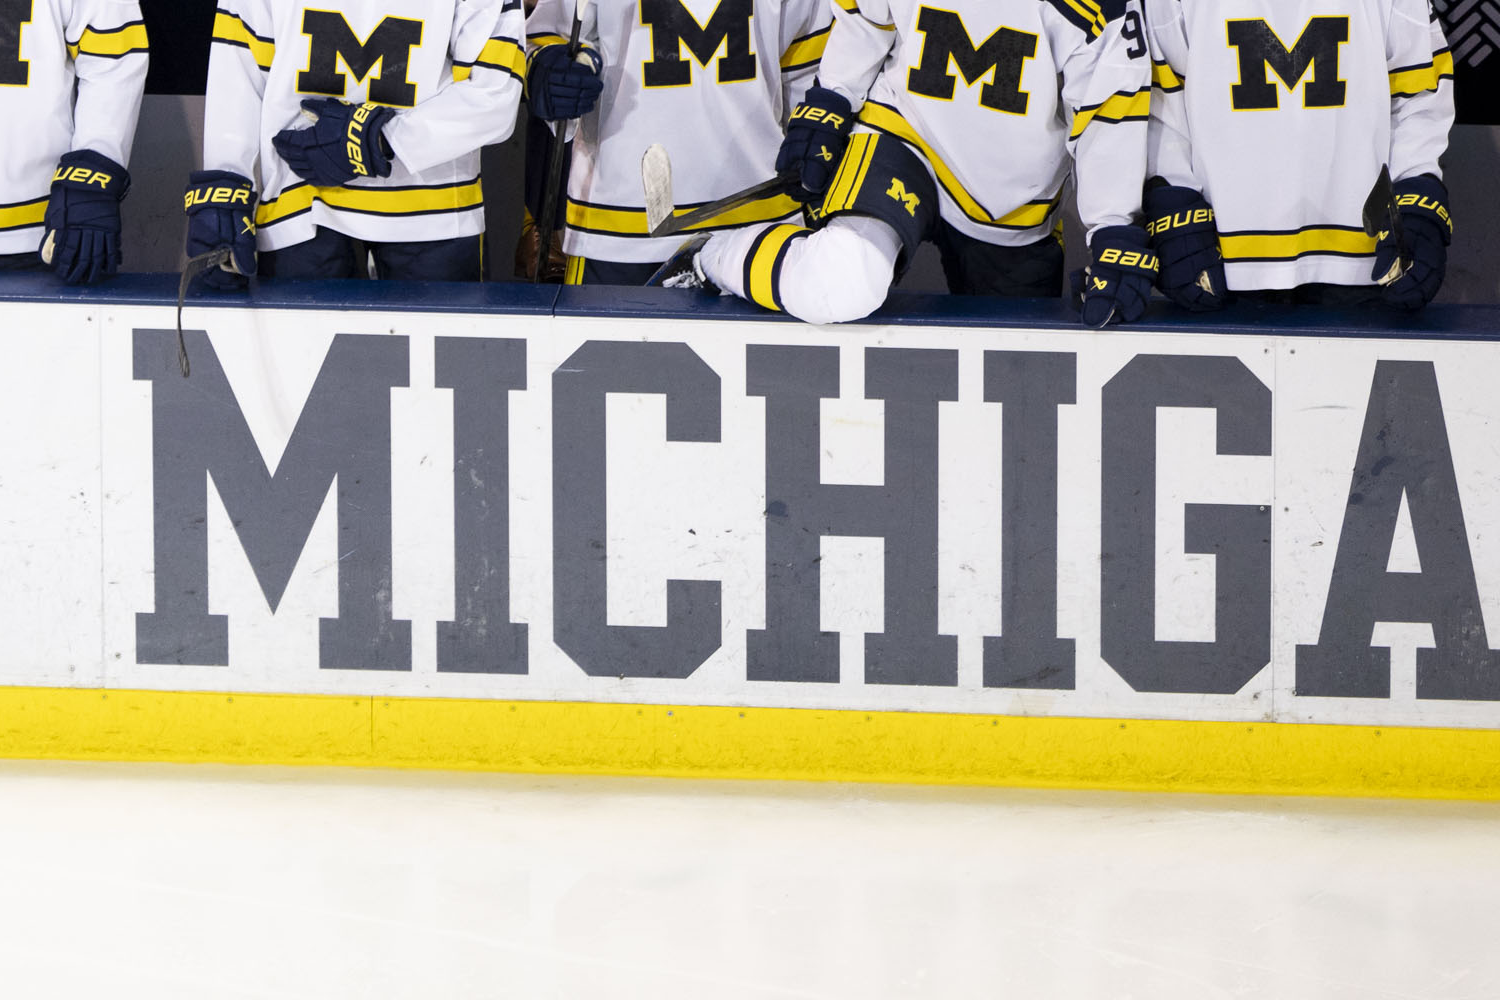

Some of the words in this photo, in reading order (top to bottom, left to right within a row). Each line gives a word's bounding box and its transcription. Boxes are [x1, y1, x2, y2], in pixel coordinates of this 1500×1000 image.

[296, 7, 425, 109] M
[906, 3, 1040, 117] M
[1225, 14, 1350, 113] M
[886, 177, 921, 218] M
[132, 328, 1500, 702] MICHIGA
